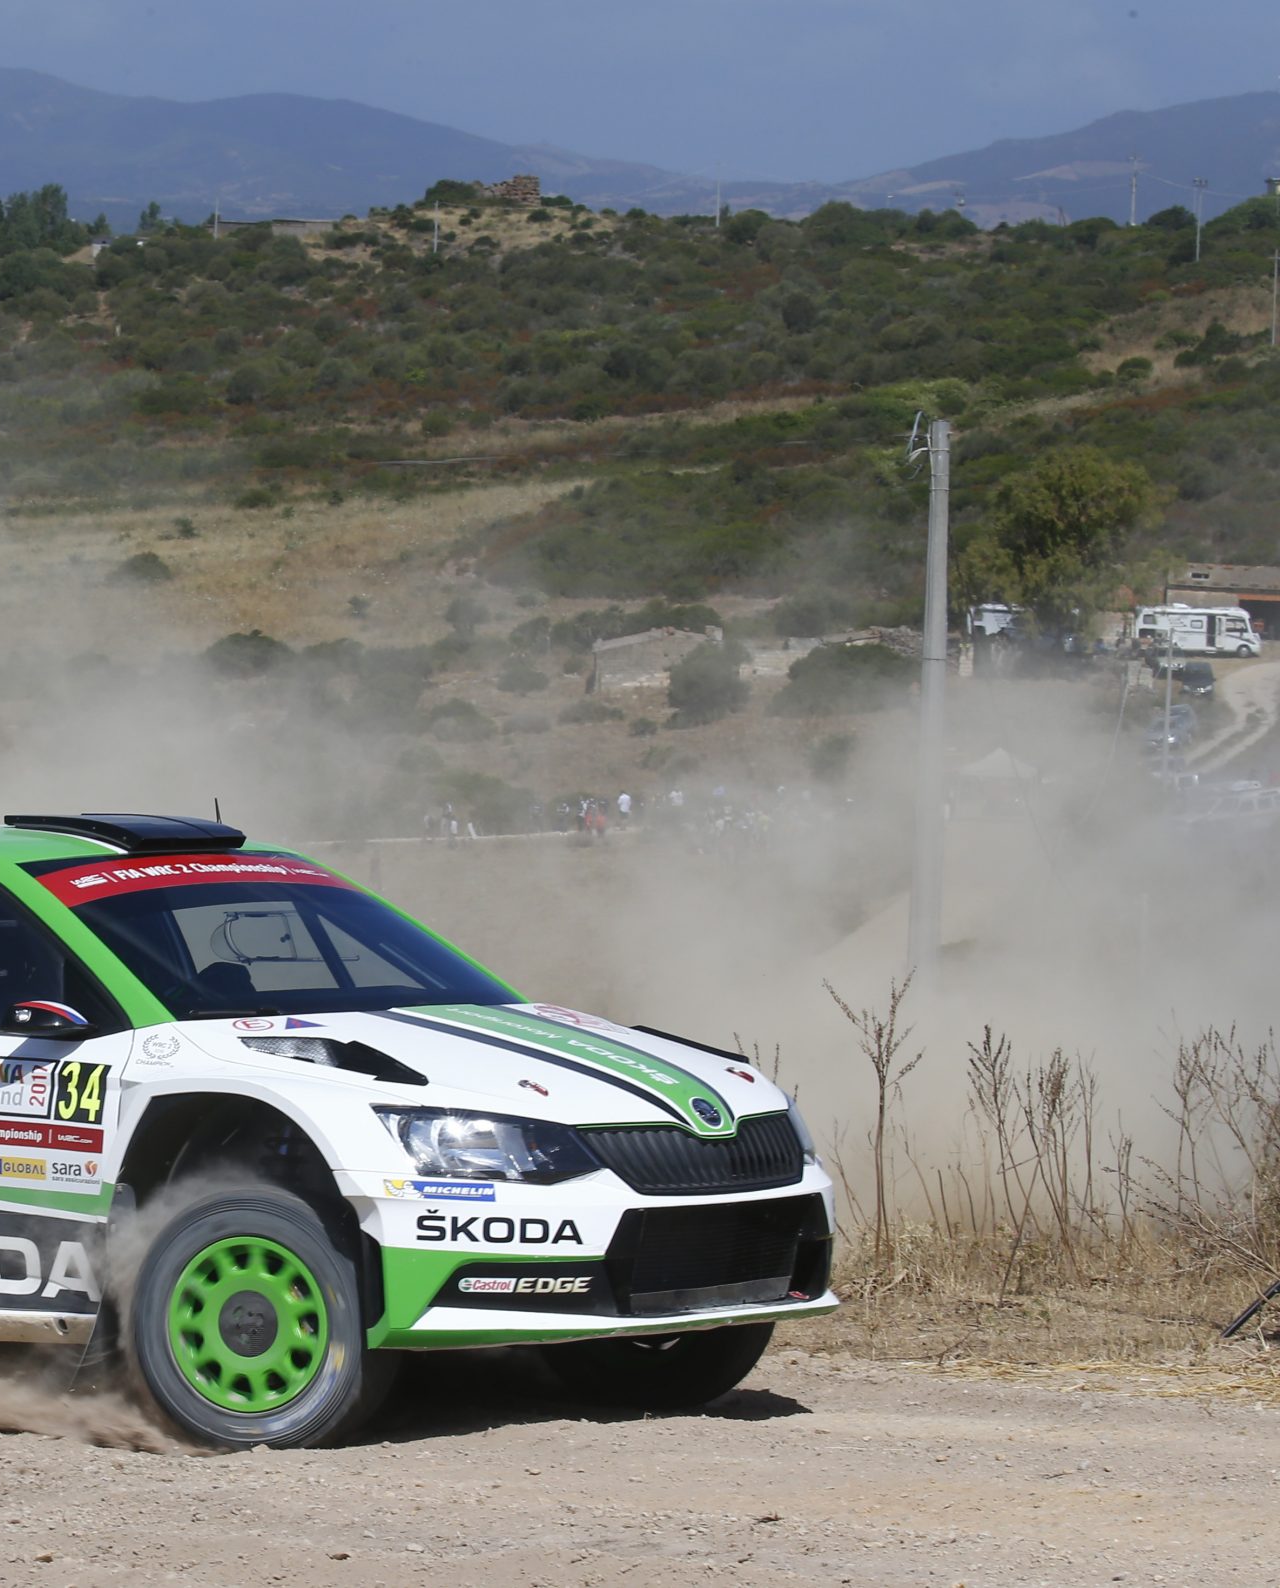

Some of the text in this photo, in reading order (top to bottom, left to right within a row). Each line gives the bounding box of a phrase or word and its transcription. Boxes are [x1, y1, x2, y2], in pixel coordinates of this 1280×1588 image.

[113, 863, 287, 880] FIA WRC 2 Championship
[29, 1063, 49, 1107] 2017
[57, 1061, 106, 1122] 34
[3, 1162, 46, 1175] GLOBAL
[52, 1162, 81, 1176] sara
[423, 1185, 495, 1195] MICHELIN
[416, 1209, 584, 1245] ŠKODA
[472, 1276, 594, 1294] Castrol EDGE
